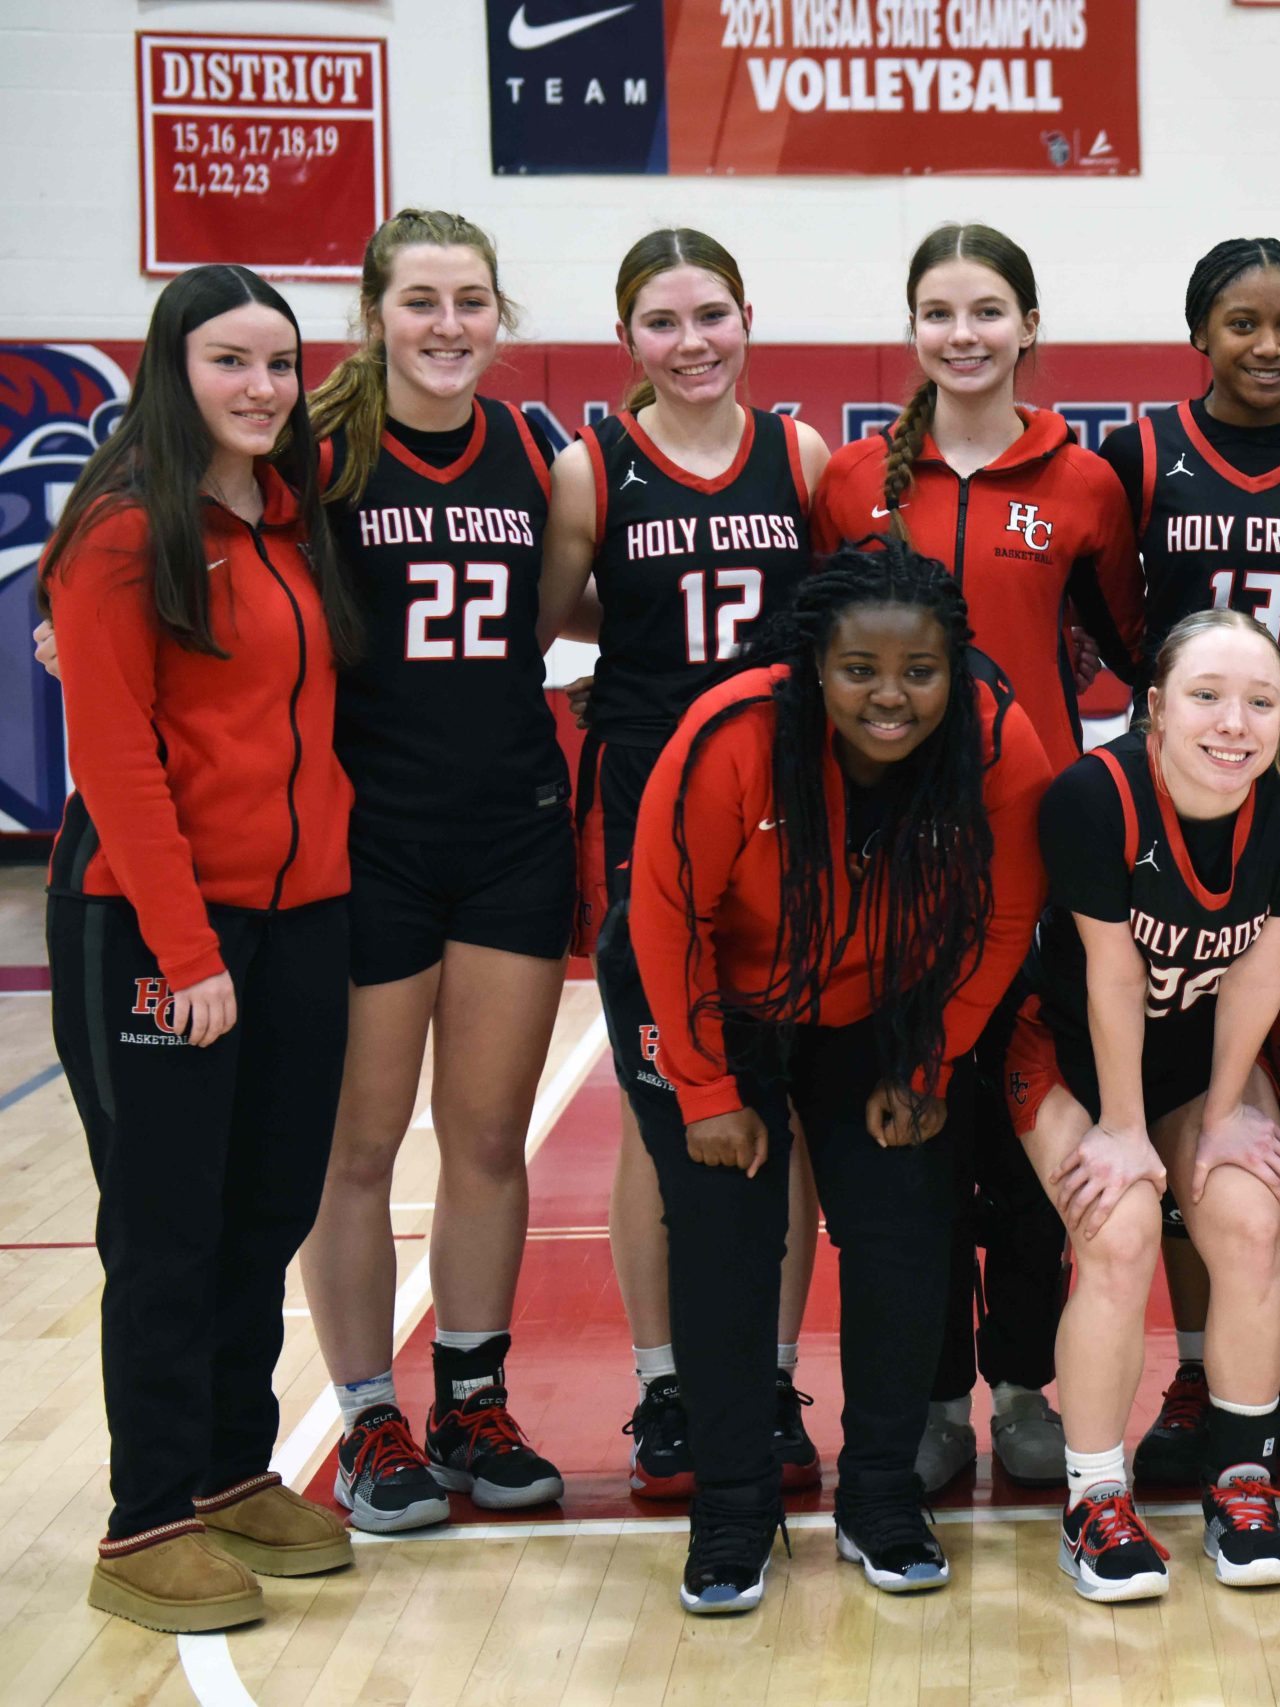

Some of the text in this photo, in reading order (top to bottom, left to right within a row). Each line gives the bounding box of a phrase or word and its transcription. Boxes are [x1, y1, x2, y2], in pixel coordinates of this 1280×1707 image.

[721, 0, 1088, 50] 2021 KHSAA STATE CHAMPIONS
[161, 51, 364, 104] DISTRICT
[505, 77, 648, 106] TEAM
[746, 57, 1063, 113] VOLLEYBALL
[359, 506, 535, 547] HOLY CROSS
[627, 513, 800, 560] HOLY CROSS
[1005, 500, 1054, 552] HC
[1166, 514, 1235, 553] HOLY
[404, 560, 511, 662] 22
[678, 566, 766, 665] 12
[1130, 904, 1271, 960] OLY CROS
[120, 1031, 190, 1046] BASKETBAL
[1100, 1489, 1121, 1501] CUT
